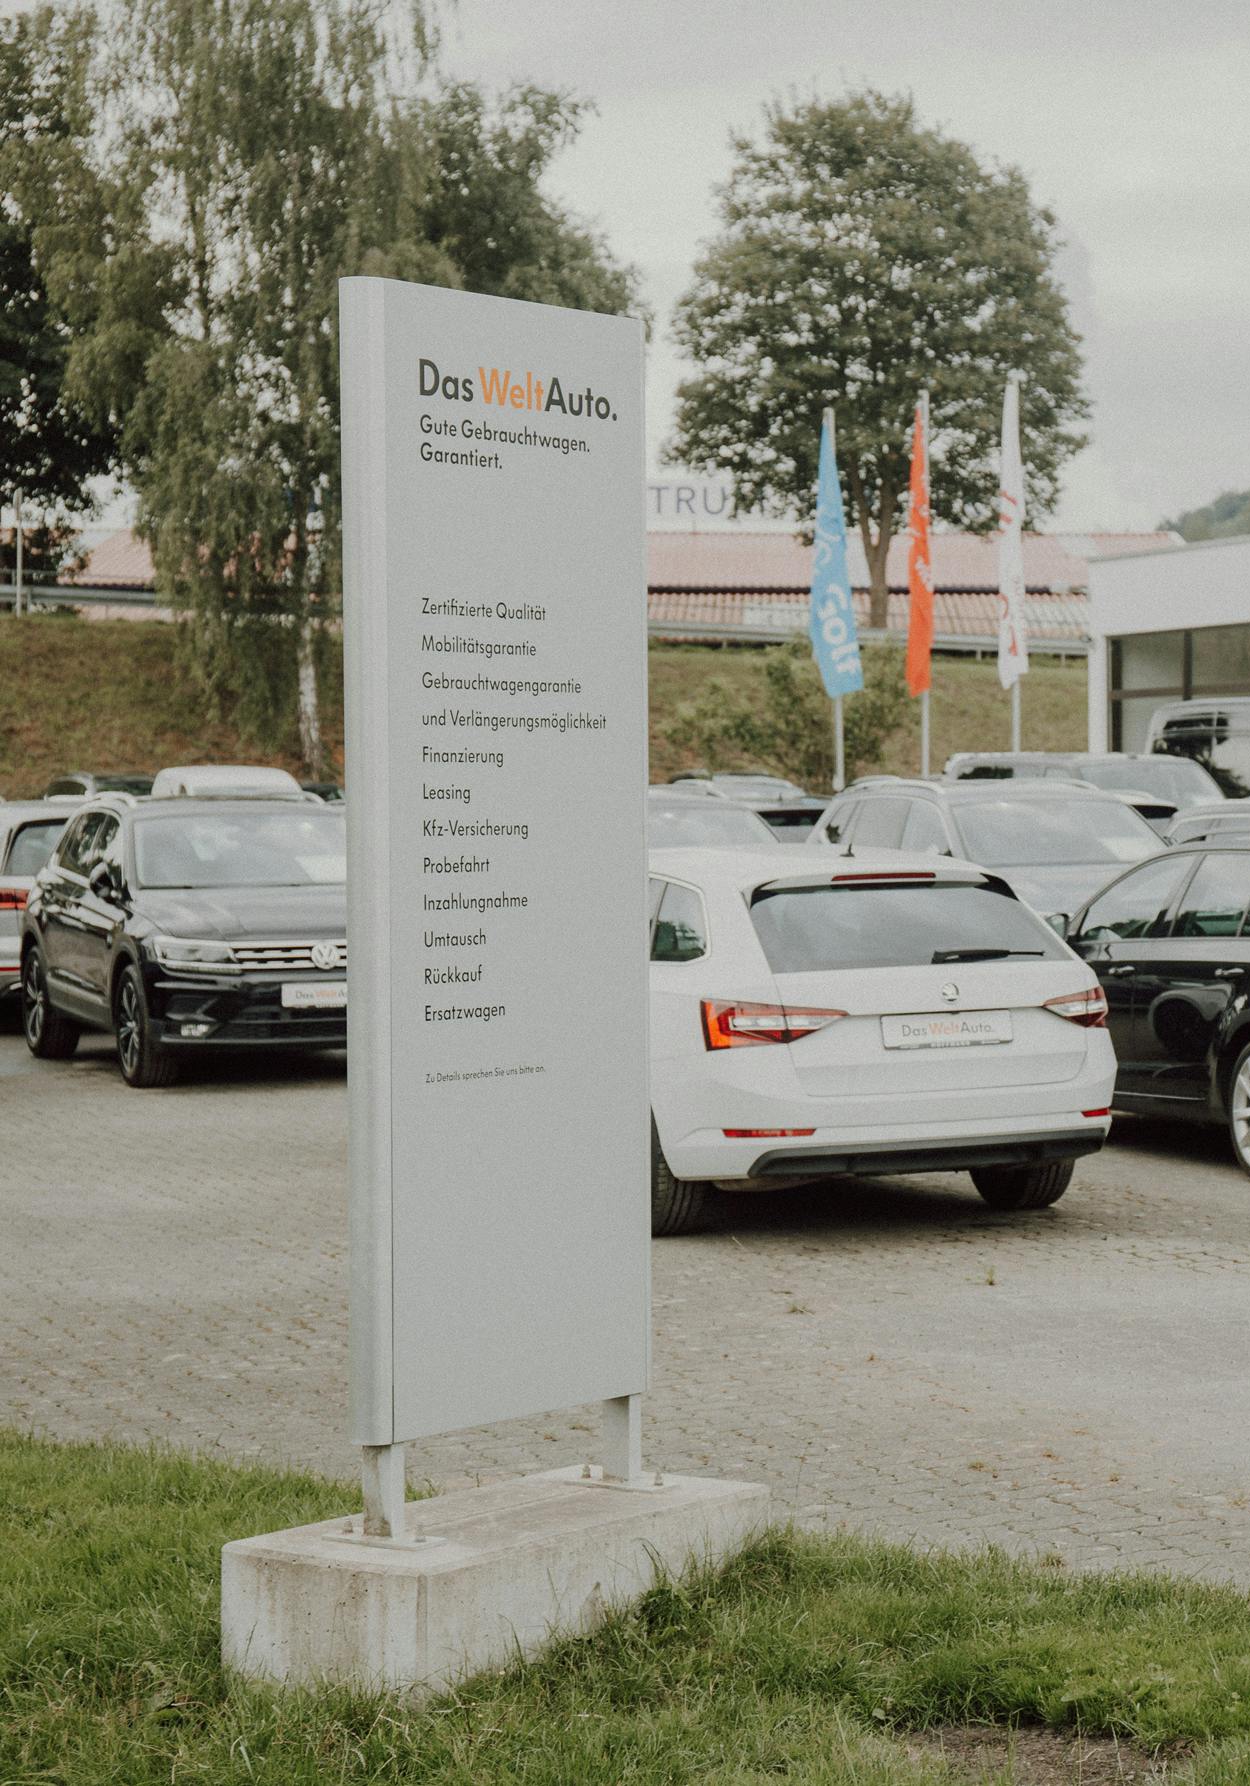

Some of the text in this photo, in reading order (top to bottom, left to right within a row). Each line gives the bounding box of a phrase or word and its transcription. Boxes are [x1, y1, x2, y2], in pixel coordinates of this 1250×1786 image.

[419, 358, 618, 422] Das WeltAuto.
[420, 413, 591, 455] Gute Gebrauchtwagen.
[420, 442, 503, 470] Garantiert.
[421, 597, 546, 621] Zertifizierte Qualität
[421, 634, 537, 659] Mobilitätsgarantie
[421, 671, 582, 697] Gebrauchtwagengarantie
[421, 708, 607, 733] und Verlängerungsmöglichkeit
[422, 746, 504, 768] Finanzierung
[422, 783, 471, 804] Leasing
[423, 818, 529, 840] Kfz-Versicherung
[423, 855, 490, 874] Probefahrt
[423, 891, 529, 913] Inzahlungnahme
[424, 928, 487, 948] Umtausch
[424, 964, 483, 985] Rückkauf
[424, 1004, 506, 1022] Ersatzwagen
[901, 1024, 927, 1037] Das
[425, 1064, 546, 1083] Zu Details sprechen Sie uns bitte an.
